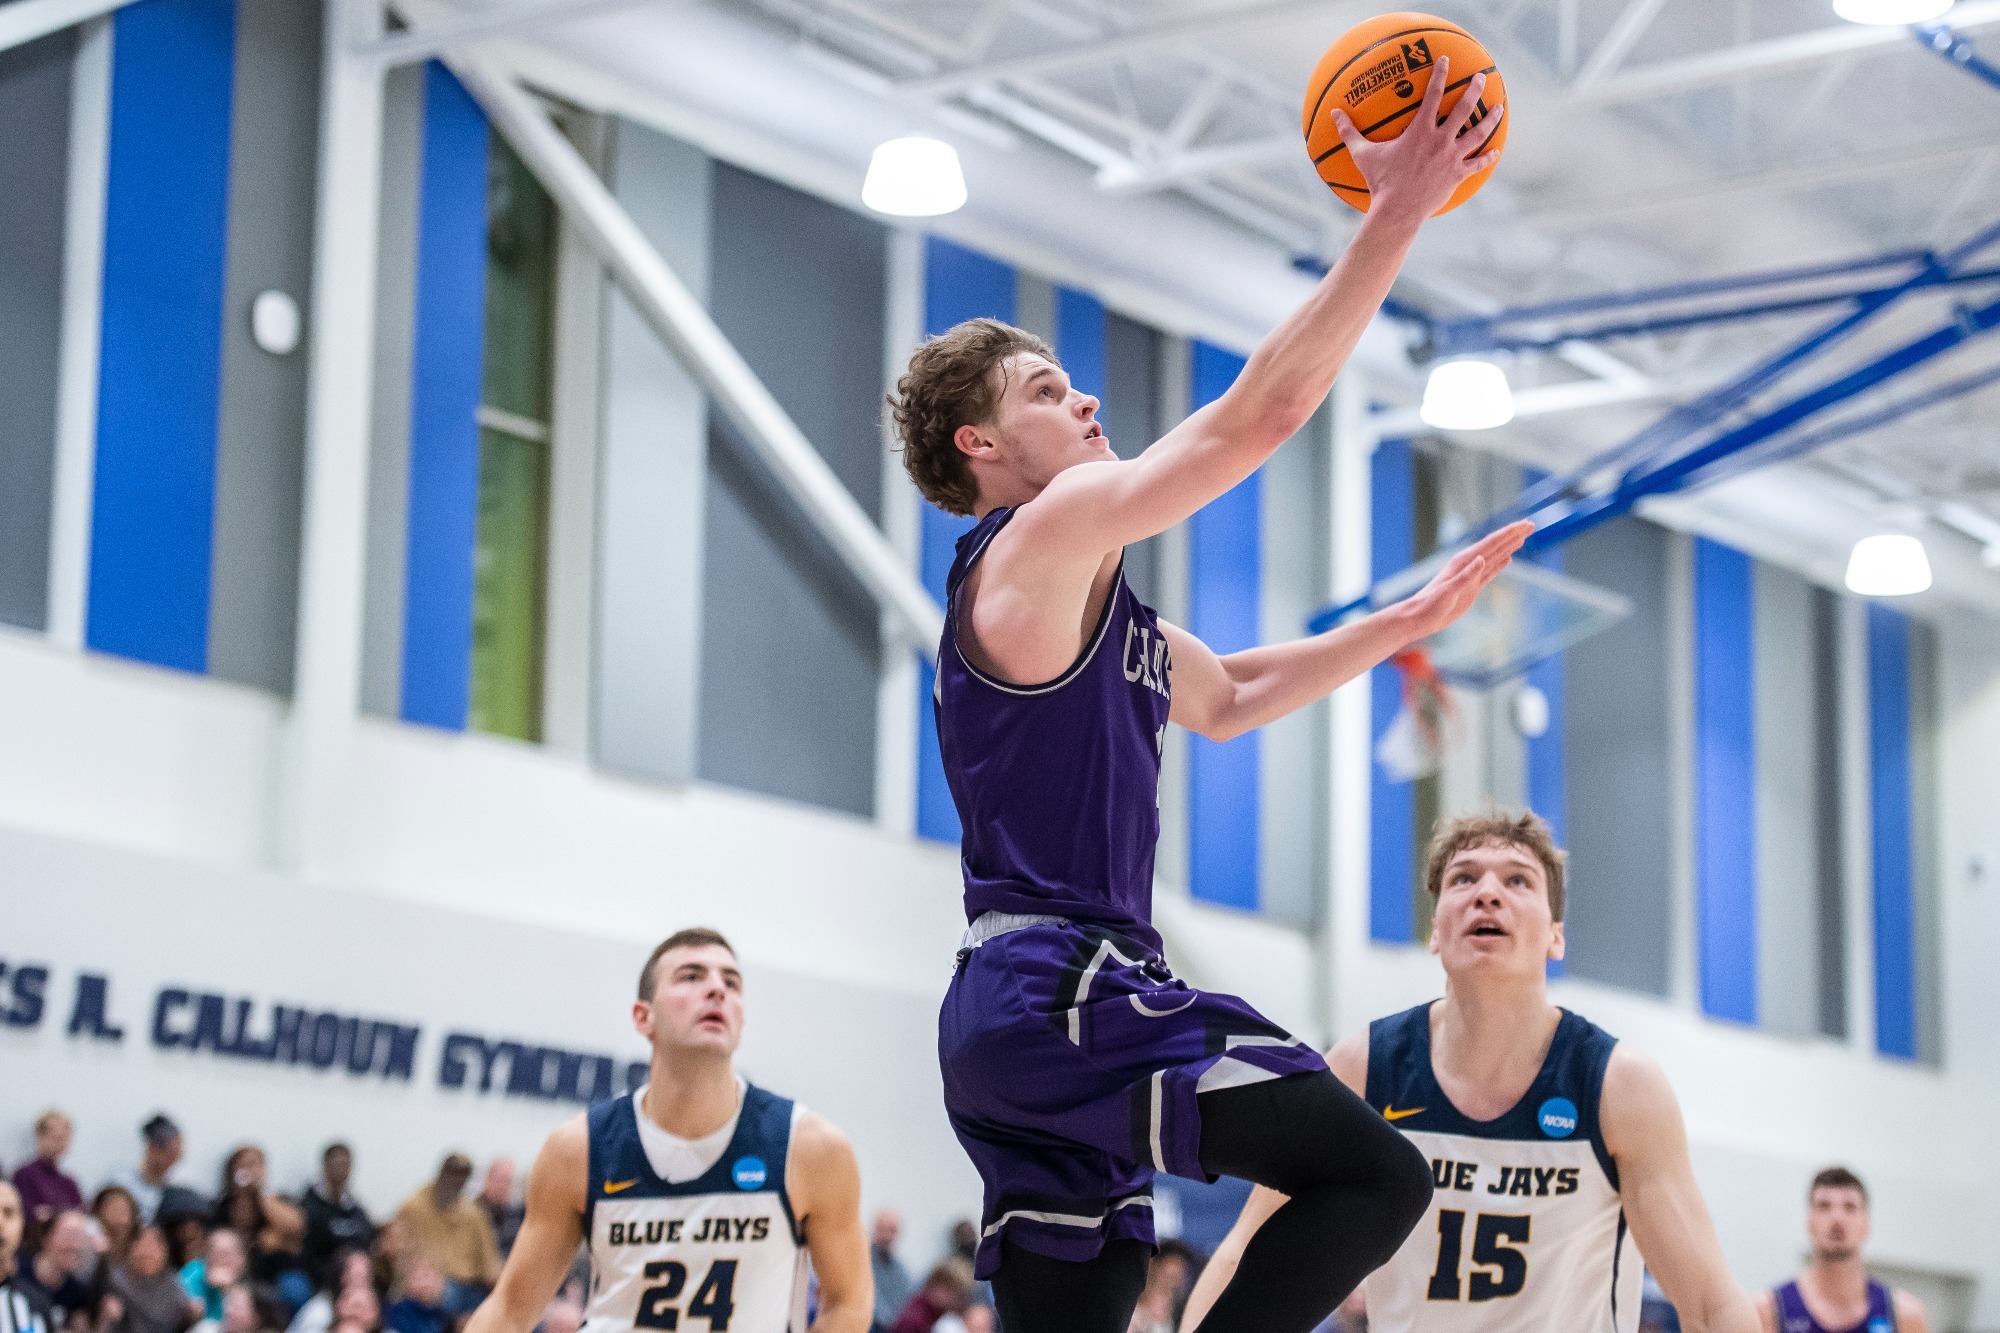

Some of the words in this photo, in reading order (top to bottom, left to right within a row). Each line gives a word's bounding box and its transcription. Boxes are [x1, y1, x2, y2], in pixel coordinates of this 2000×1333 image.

[1344, 61, 1405, 105] BASKETBALL
[1350, 54, 1402, 88] CHAMPIONSHIP
[151, 987, 419, 1080] CALHOUN
[1431, 1158, 1478, 1192] UE
[1487, 1167, 1581, 1197] JAYS
[609, 1220, 685, 1247] BLUE
[692, 1216, 770, 1243] JAYS
[1426, 1208, 1532, 1303] 15
[633, 1258, 740, 1333] 24
